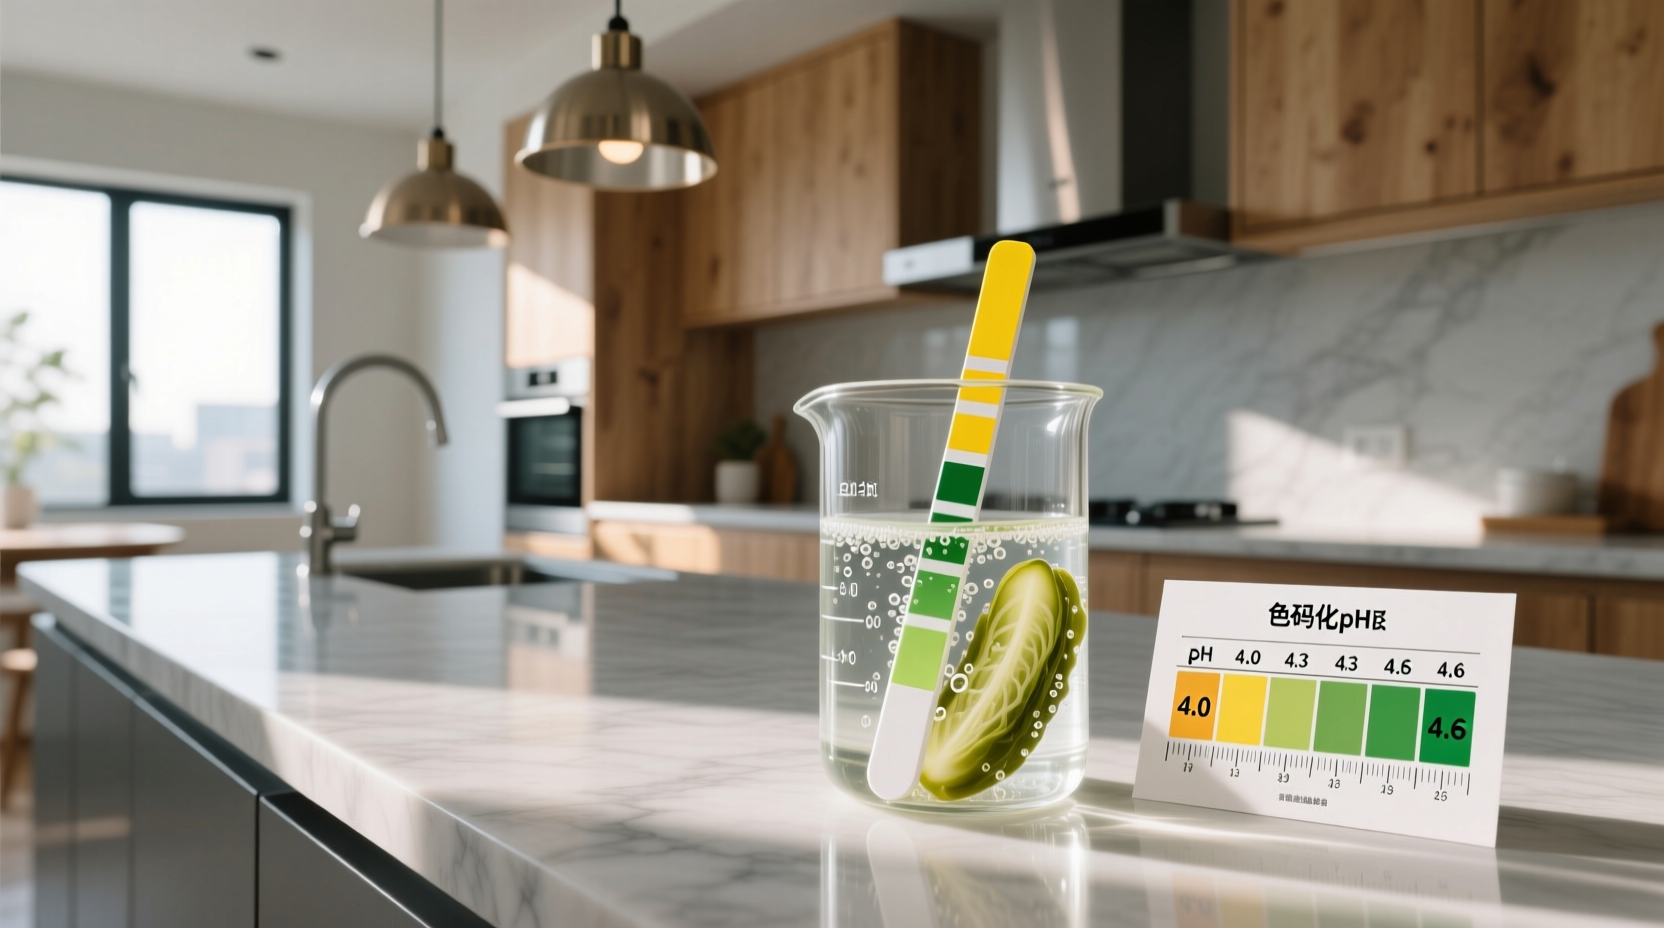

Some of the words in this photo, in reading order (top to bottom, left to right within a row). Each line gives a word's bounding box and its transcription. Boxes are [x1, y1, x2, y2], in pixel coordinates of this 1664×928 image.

[1188, 646, 1213, 665] pH
[1235, 649, 1261, 665] 4.0
[1284, 652, 1309, 668] 4.3
[1335, 655, 1358, 672] 4.3
[1383, 658, 1412, 675] 4.6
[1437, 662, 1465, 678] 4.6
[1176, 695, 1211, 718] 4.0
[1427, 717, 1467, 741] 4.6
